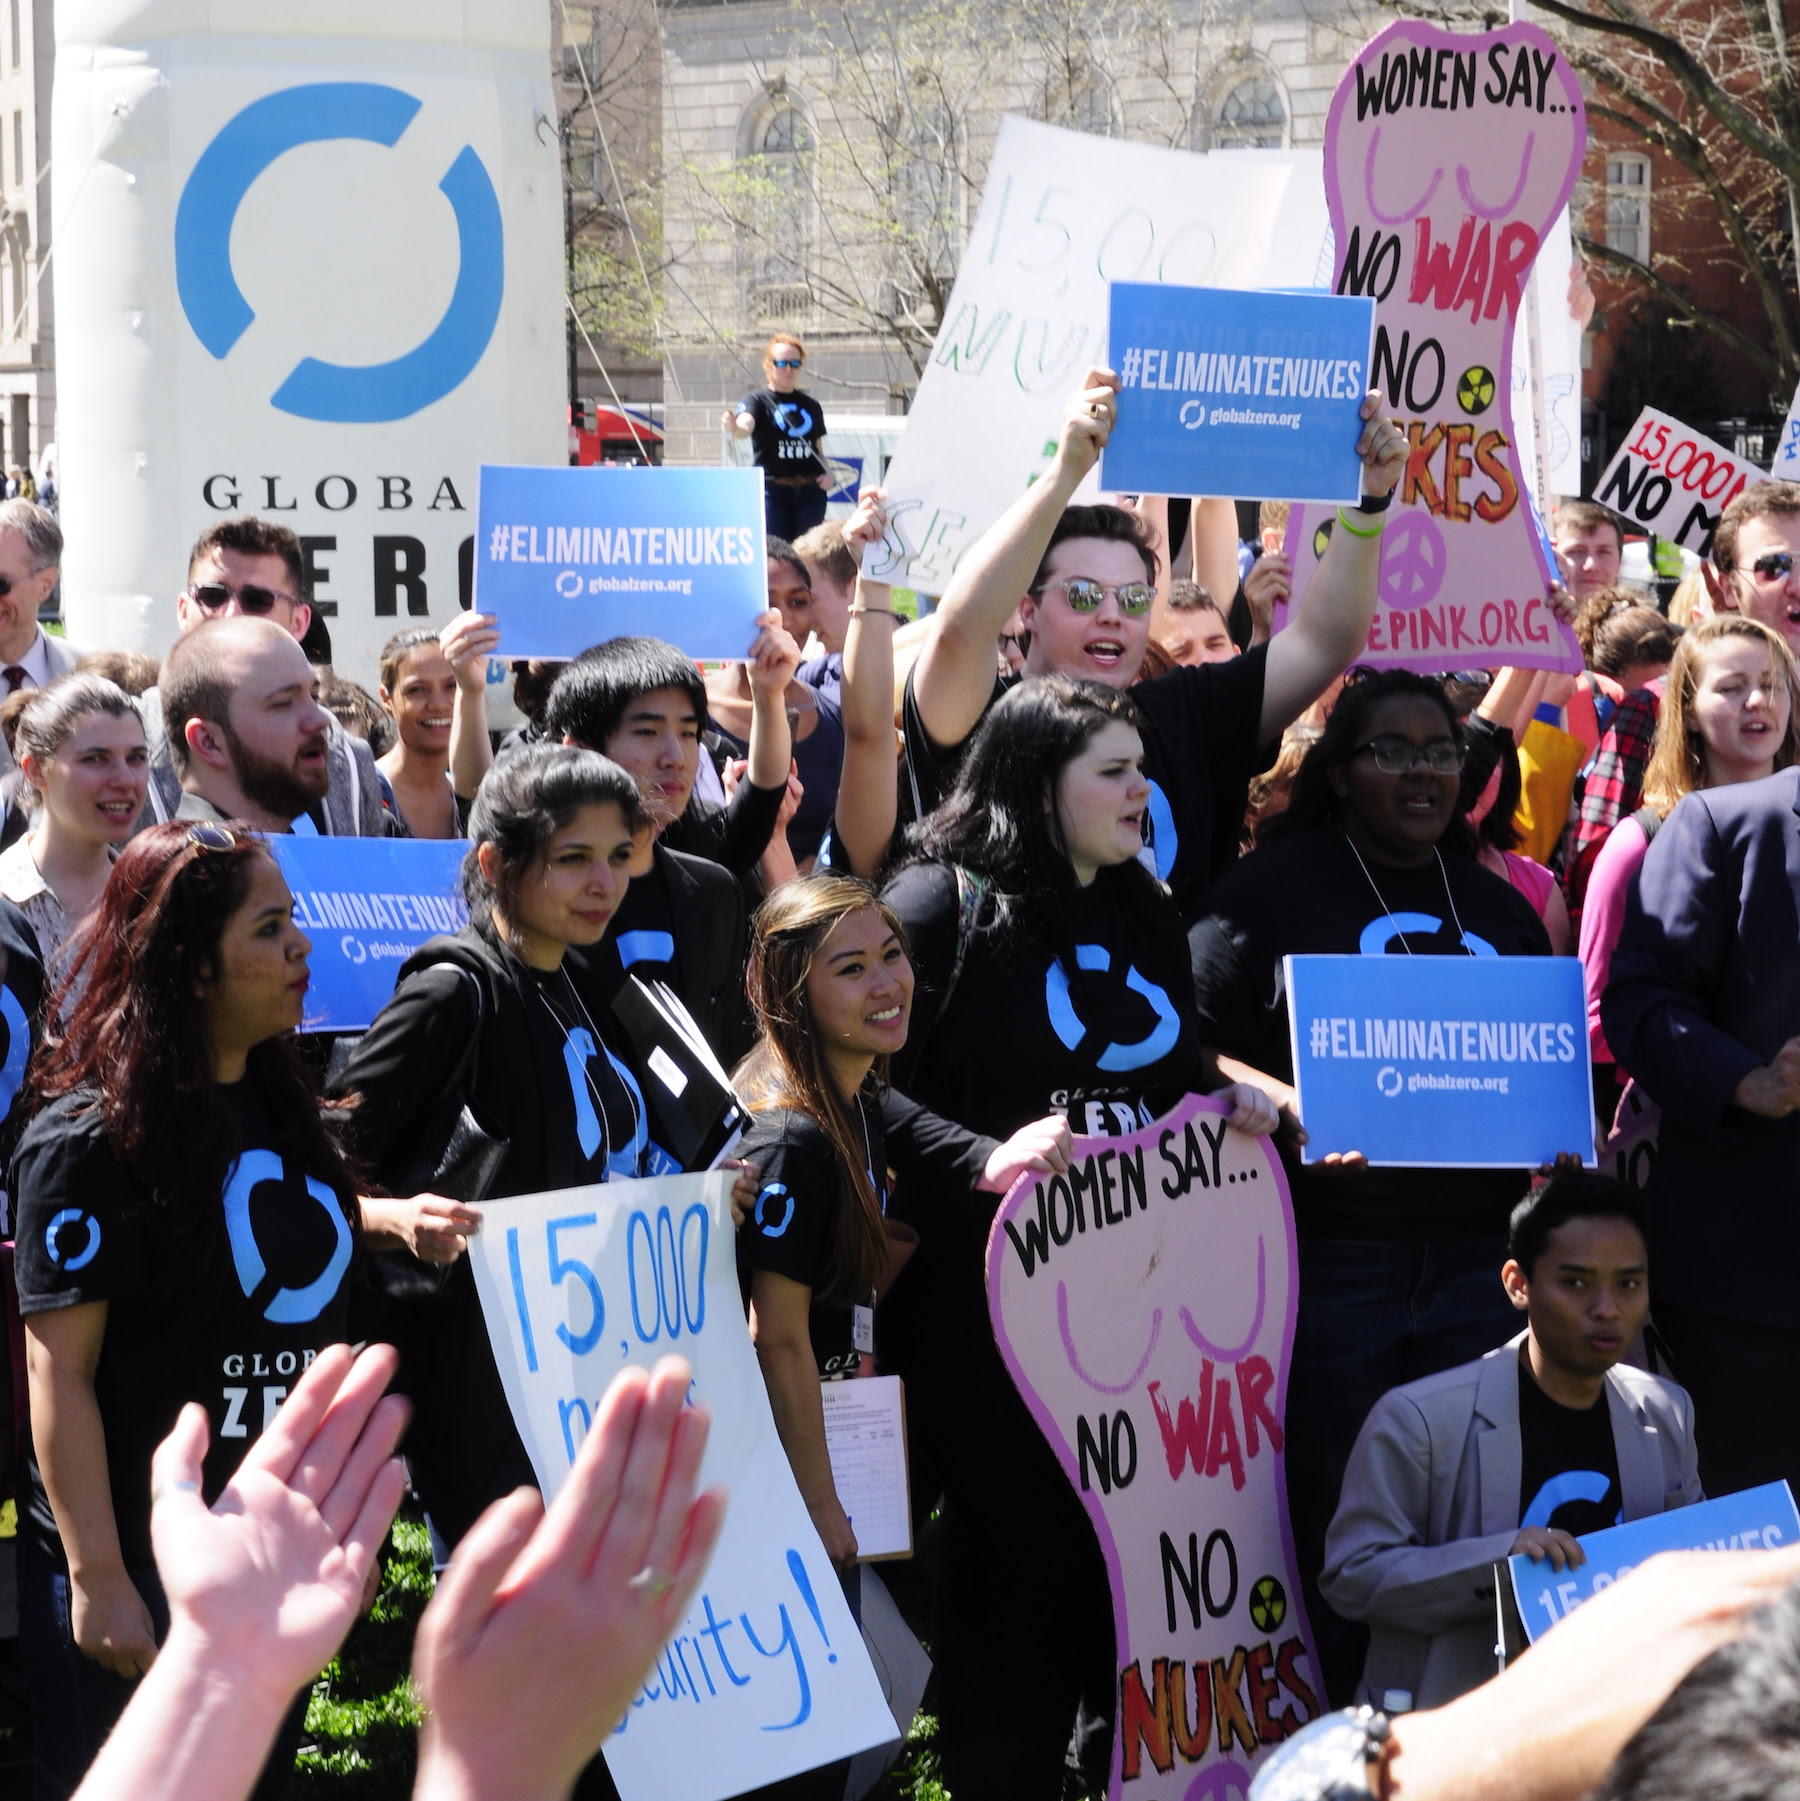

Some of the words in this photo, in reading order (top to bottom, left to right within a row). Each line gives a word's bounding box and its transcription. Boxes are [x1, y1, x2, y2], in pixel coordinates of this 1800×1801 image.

[1356, 46, 1476, 122] WOMEN
[1484, 43, 1577, 114] SAY...
[1337, 225, 1401, 303] NO
[1408, 214, 1538, 327] WAR
[1121, 347, 1361, 400] #ELIMINATENUKES
[1370, 324, 1446, 413] NO
[1210, 407, 1303, 430] globalzero.org
[203, 474, 467, 511] GLOBA
[1392, 420, 1519, 525] KES
[1600, 455, 1672, 522] NO
[298, 535, 475, 617] ER
[490, 525, 755, 565] #ELIMINATENUKES
[589, 576, 693, 595] globalzero.org
[1367, 599, 1550, 652] EPINK.ORG
[291, 891, 470, 932] ELIMINATENUK
[1310, 1017, 1576, 1063] #ELIMINATENUKES
[1407, 1073, 1509, 1095] globalzero.org
[1003, 1145, 1147, 1278] WOMEN
[1159, 1118, 1258, 1200] SAY...
[507, 1202, 709, 1373] 15,000
[220, 1386, 287, 1438] ZE
[1077, 1409, 1137, 1495] NO
[1147, 1354, 1285, 1492] WAR
[1160, 1528, 1238, 1633] NO
[612, 1548, 838, 1734] urity!
[1120, 1635, 1321, 1783] NUKES
